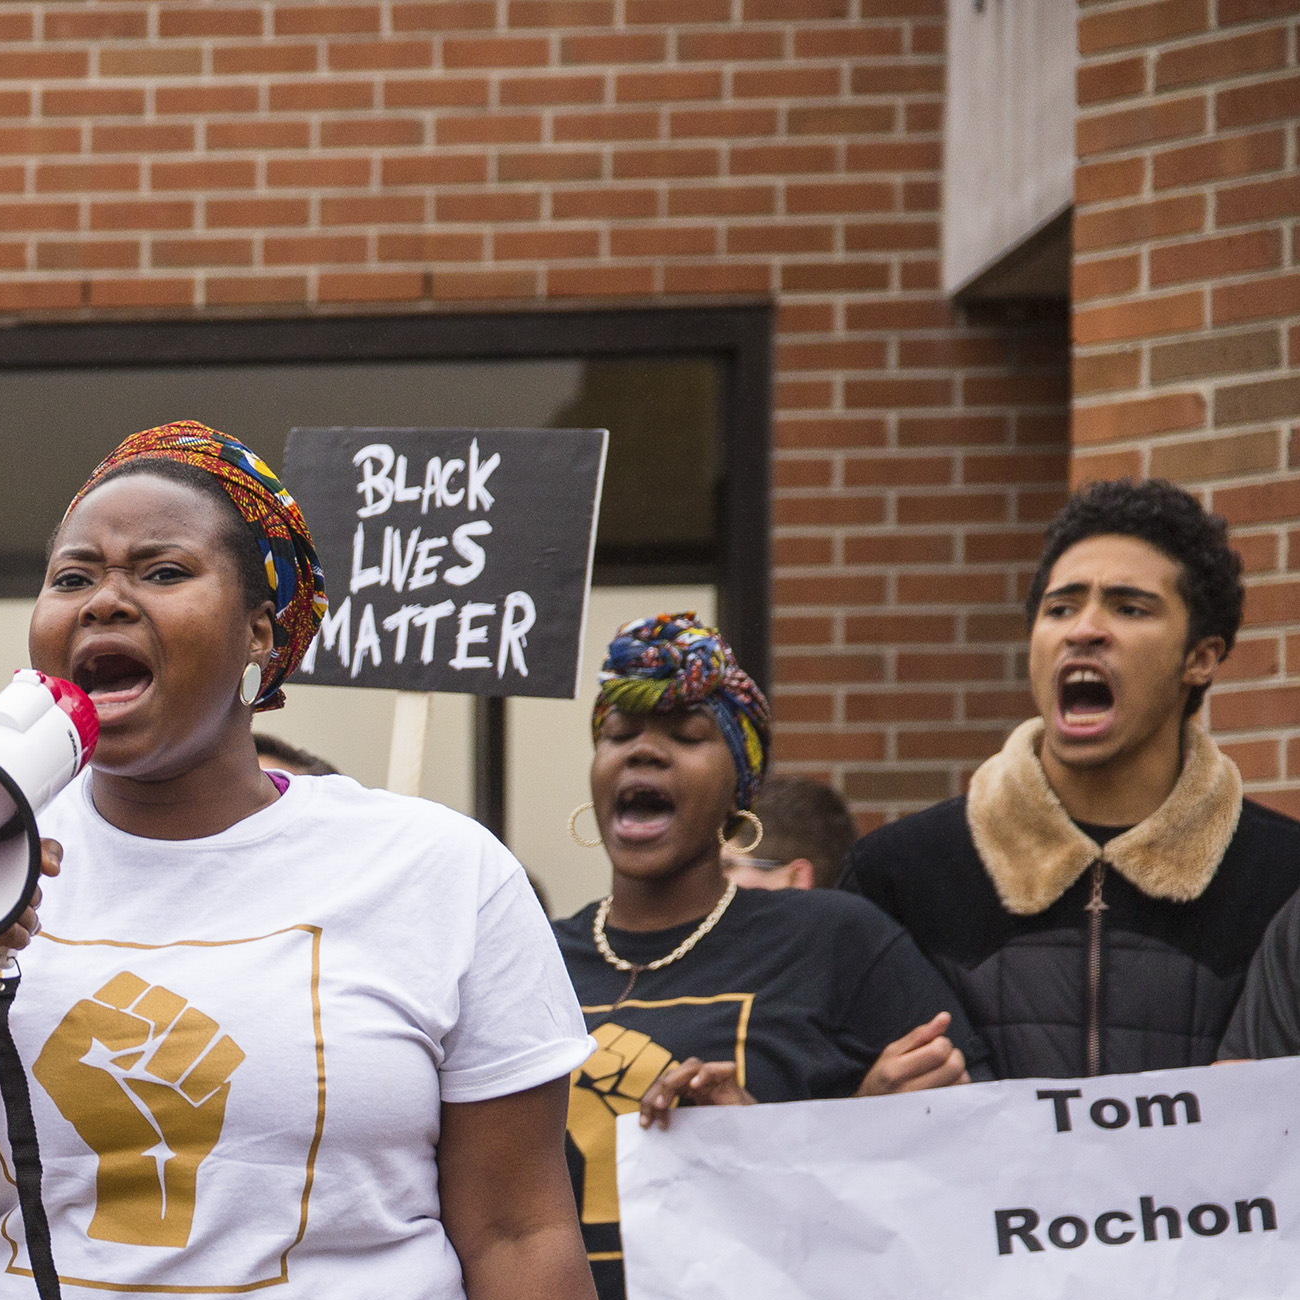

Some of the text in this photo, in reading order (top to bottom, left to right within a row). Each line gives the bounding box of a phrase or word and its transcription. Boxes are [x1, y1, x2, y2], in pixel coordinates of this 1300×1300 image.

[353, 438, 501, 518] BLACK
[349, 520, 493, 594] LIVES
[301, 591, 537, 679] MATTER
[1036, 1088, 1202, 1133] Tom
[994, 1195, 1278, 1256] Rochon
